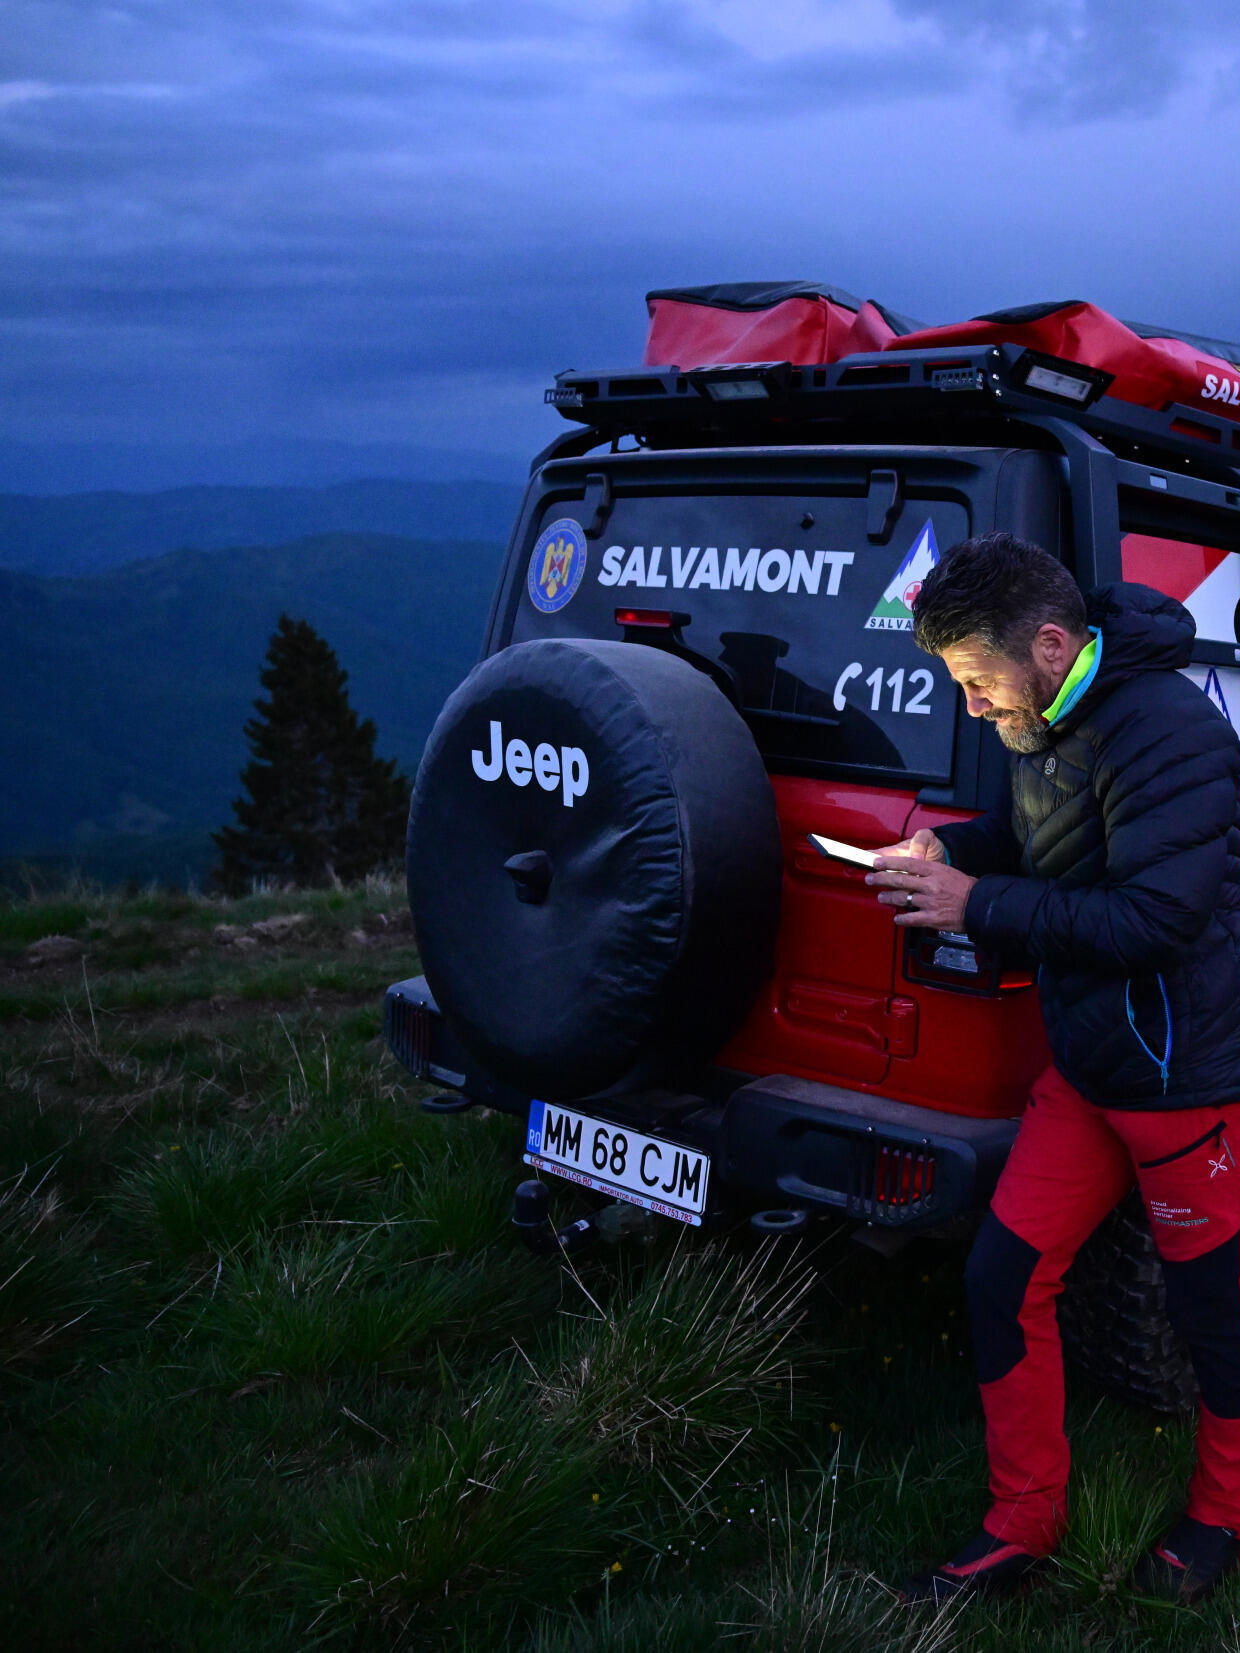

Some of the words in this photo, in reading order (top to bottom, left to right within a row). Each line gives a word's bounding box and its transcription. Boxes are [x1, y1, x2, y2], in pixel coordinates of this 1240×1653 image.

[597, 545, 855, 596] SALVAMONT
[869, 618, 913, 630] SALVA
[865, 667, 934, 714] 112
[471, 720, 589, 807] Jeep
[528, 1129, 541, 1148] RO
[543, 1110, 583, 1162] MM
[591, 1128, 628, 1176] 68
[640, 1143, 703, 1203] CJM
[550, 1165, 593, 1187] WWW.LCG.RO
